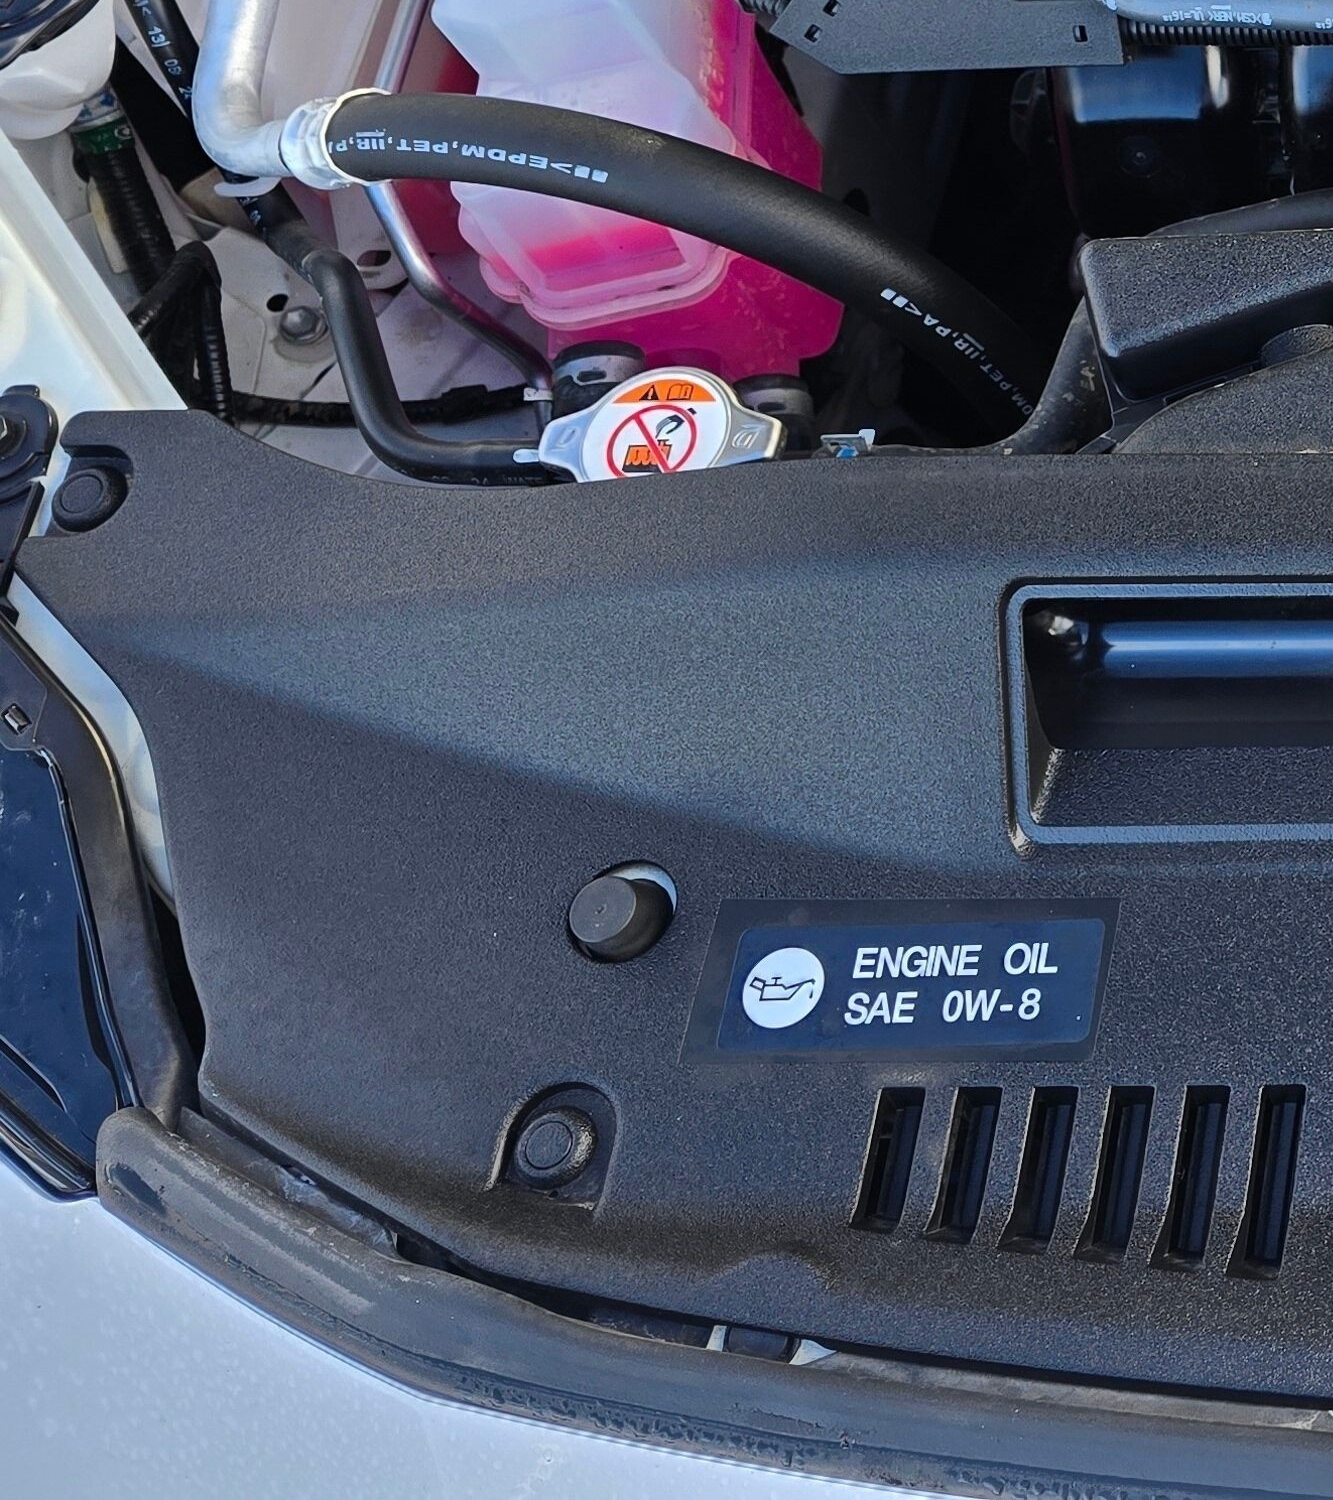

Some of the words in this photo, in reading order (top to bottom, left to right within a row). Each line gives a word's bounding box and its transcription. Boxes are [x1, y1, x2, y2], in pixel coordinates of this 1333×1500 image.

[328, 129, 573, 175] >EPDM,PET,IIR,P
[852, 944, 982, 979] ENGINE
[1003, 942, 1058, 975] OIL
[844, 991, 918, 1025] SAE
[942, 988, 1042, 1022] 0W-8
